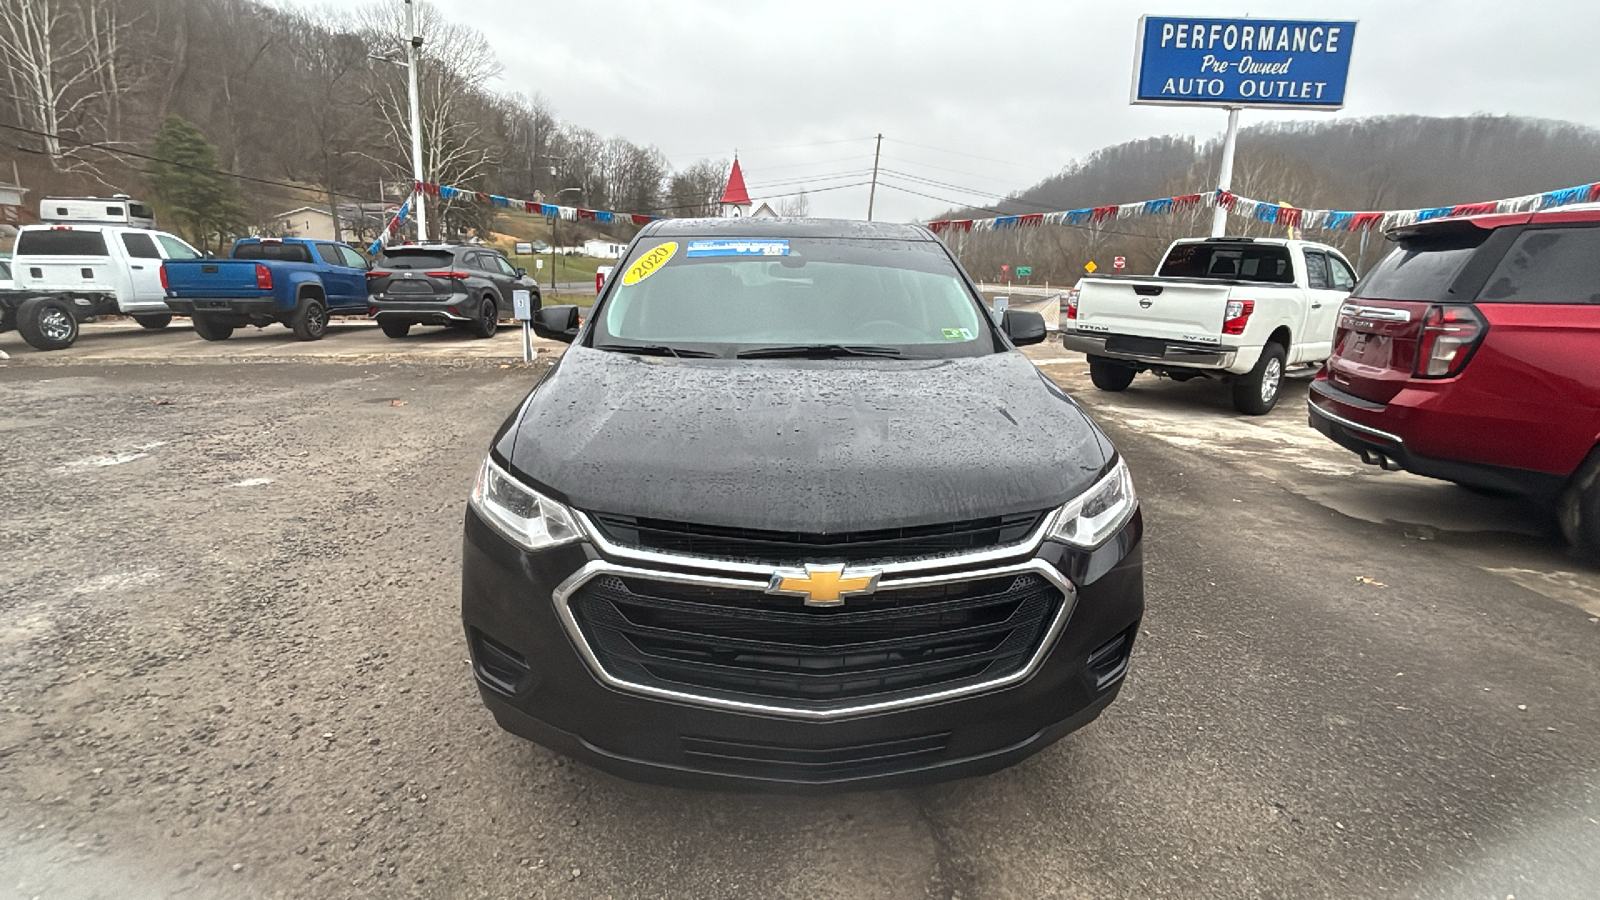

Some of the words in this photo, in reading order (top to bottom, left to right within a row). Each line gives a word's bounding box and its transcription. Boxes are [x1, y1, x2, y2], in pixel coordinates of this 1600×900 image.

[1161, 23, 1341, 53] PERFORMANCE
[1201, 54, 1293, 75] Pre-Owned
[1161, 78, 1225, 97] AUTO
[1239, 79, 1327, 99] OUTLET
[633, 247, 669, 278] 2020
